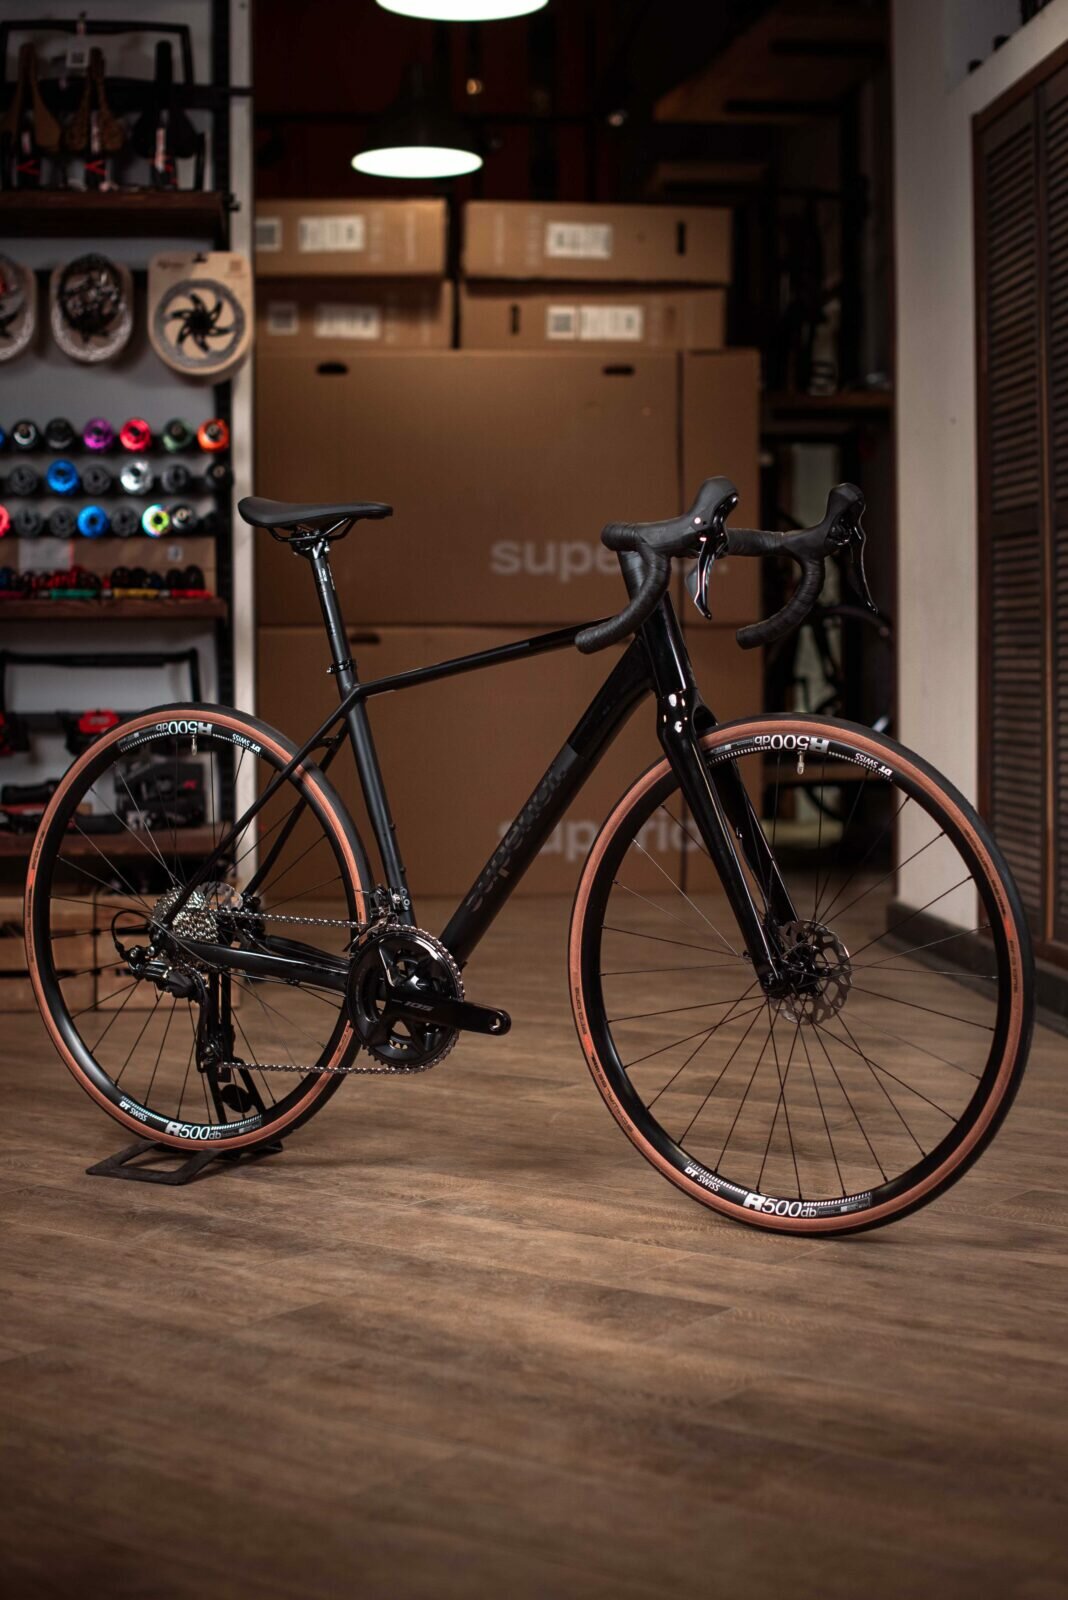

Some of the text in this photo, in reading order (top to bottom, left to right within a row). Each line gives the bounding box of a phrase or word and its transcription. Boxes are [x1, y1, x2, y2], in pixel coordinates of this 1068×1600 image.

[232, 733, 262, 753] DT SWISS
[754, 734, 830, 753] R500db
[855, 752, 893, 777] DT SWISS
[119, 1101, 148, 1122] DT SWISS
[165, 1121, 222, 1140] R500db
[683, 1166, 721, 1192] DT SWISS
[742, 1192, 817, 1217] R500db
